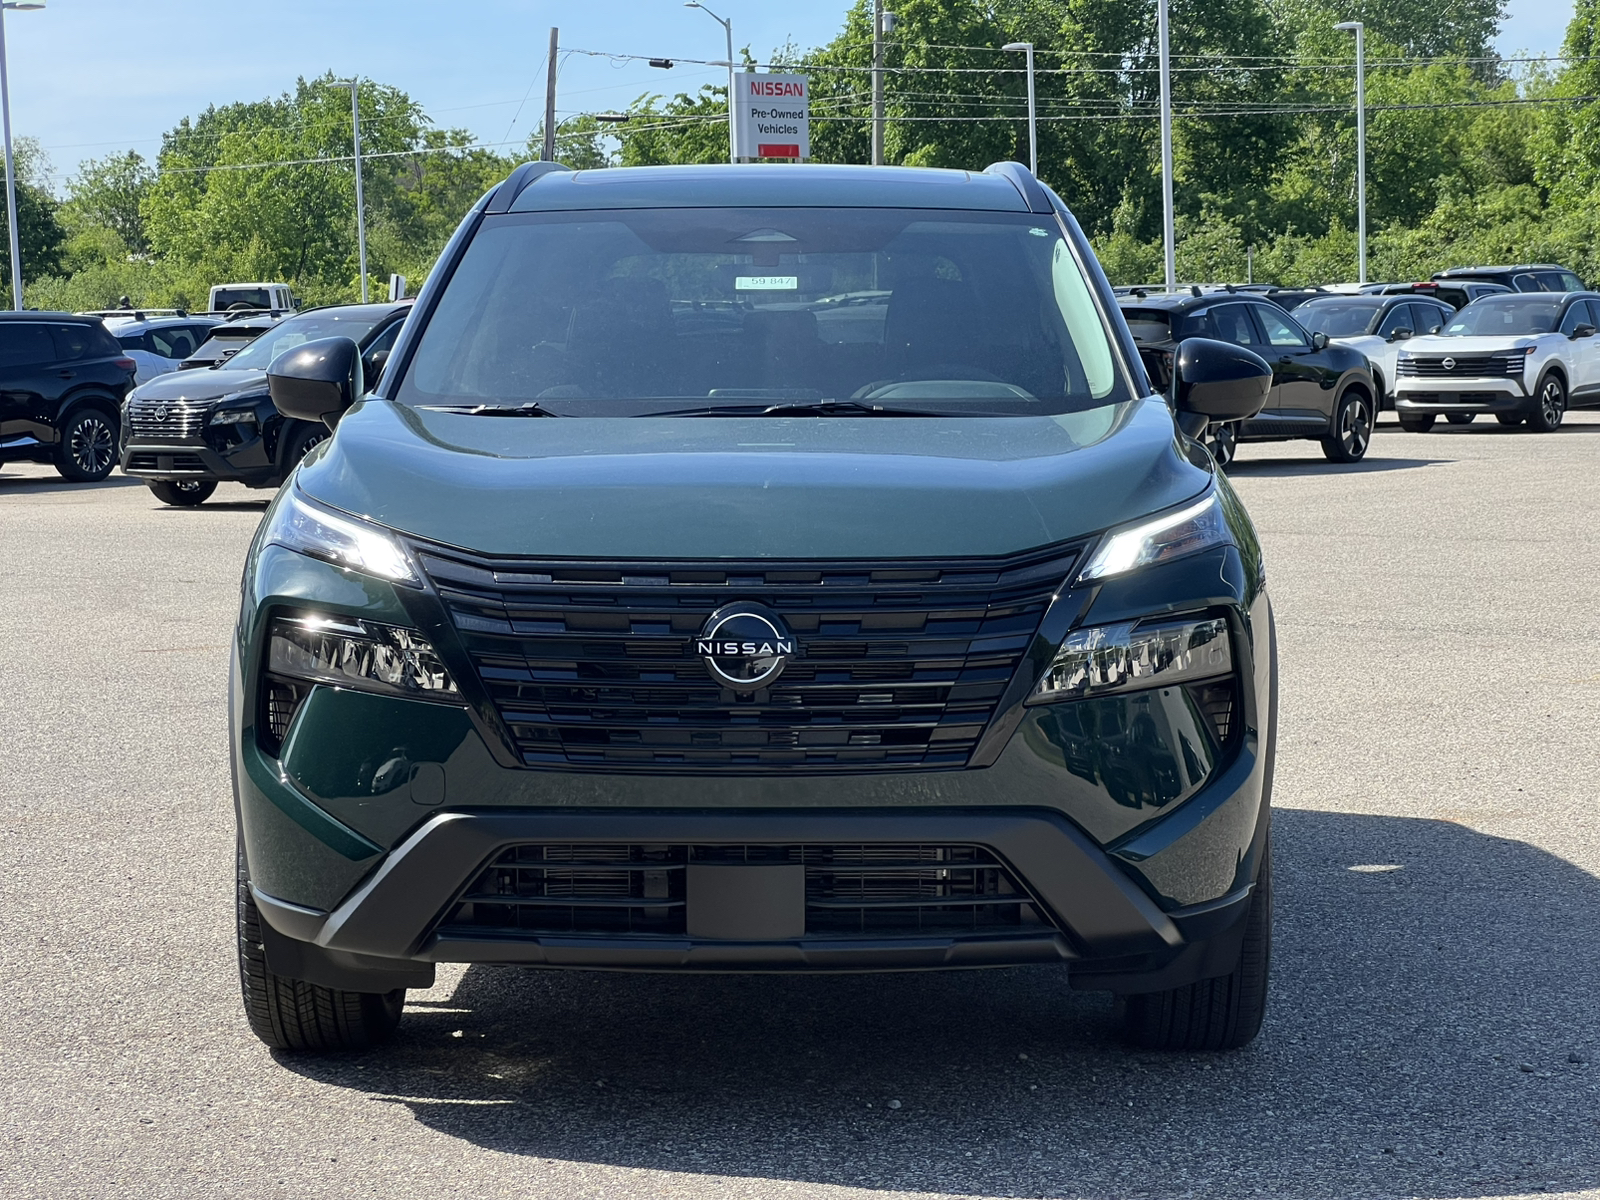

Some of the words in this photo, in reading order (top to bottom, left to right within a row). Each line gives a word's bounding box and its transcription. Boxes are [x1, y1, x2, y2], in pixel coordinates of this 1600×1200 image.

[750, 81, 804, 97] NISSAN
[751, 108, 804, 120] Pre-Owned
[757, 123, 798, 135] Vehicles
[698, 641, 792, 655] NISSAN
